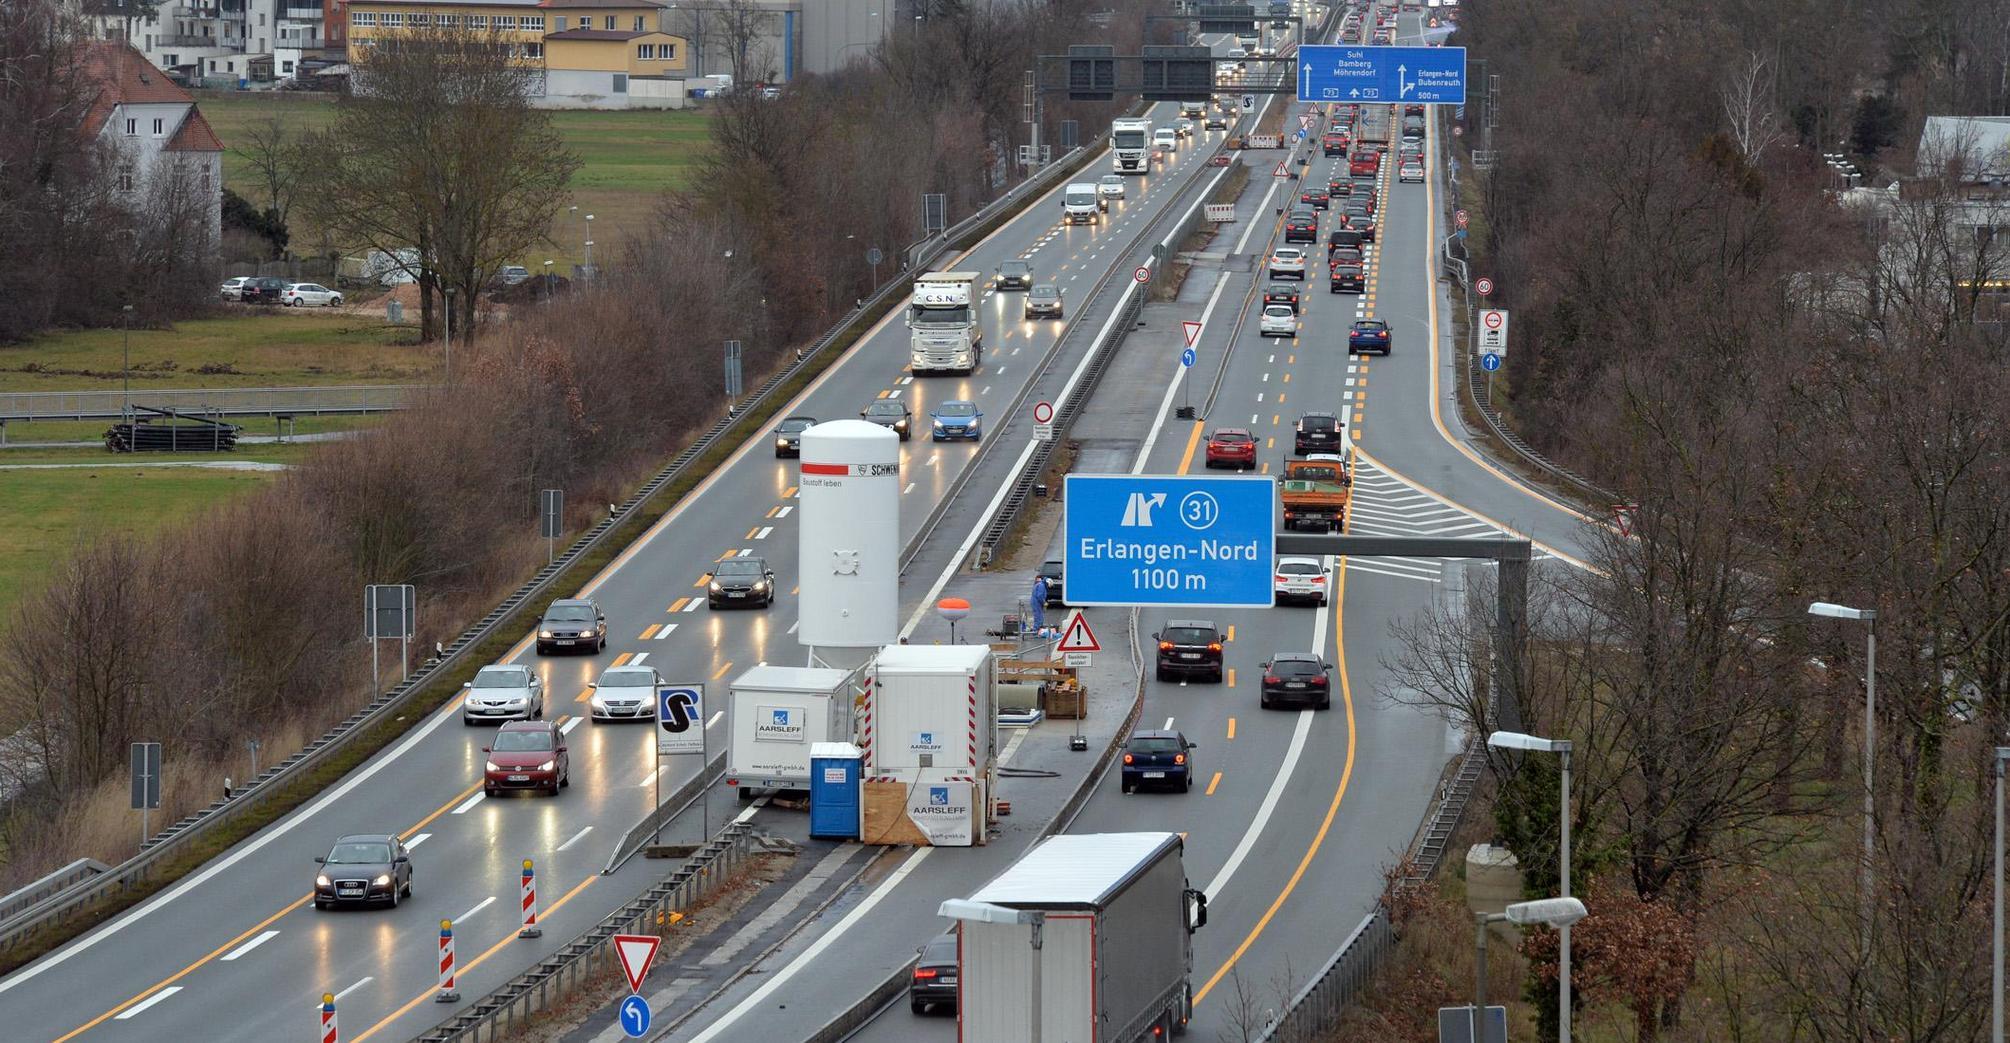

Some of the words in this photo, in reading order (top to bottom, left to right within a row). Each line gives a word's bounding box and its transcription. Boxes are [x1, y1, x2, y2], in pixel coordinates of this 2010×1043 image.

[1338, 60, 1372, 68] Bamberg
[1333, 68, 1376, 76] Möhrendorf
[1418, 70, 1459, 79] Erlangen-Nord
[1418, 79, 1460, 87] Bubenreuth
[1479, 281, 1489, 291] 60
[1188, 500, 1210, 521] 31
[1081, 538, 1258, 565] Erlangen-Nord
[1131, 568, 1179, 590] 1100
[1185, 573, 1207, 590] m
[759, 725, 802, 733] AARSLEFF
[913, 806, 967, 814] AARSLEFF
